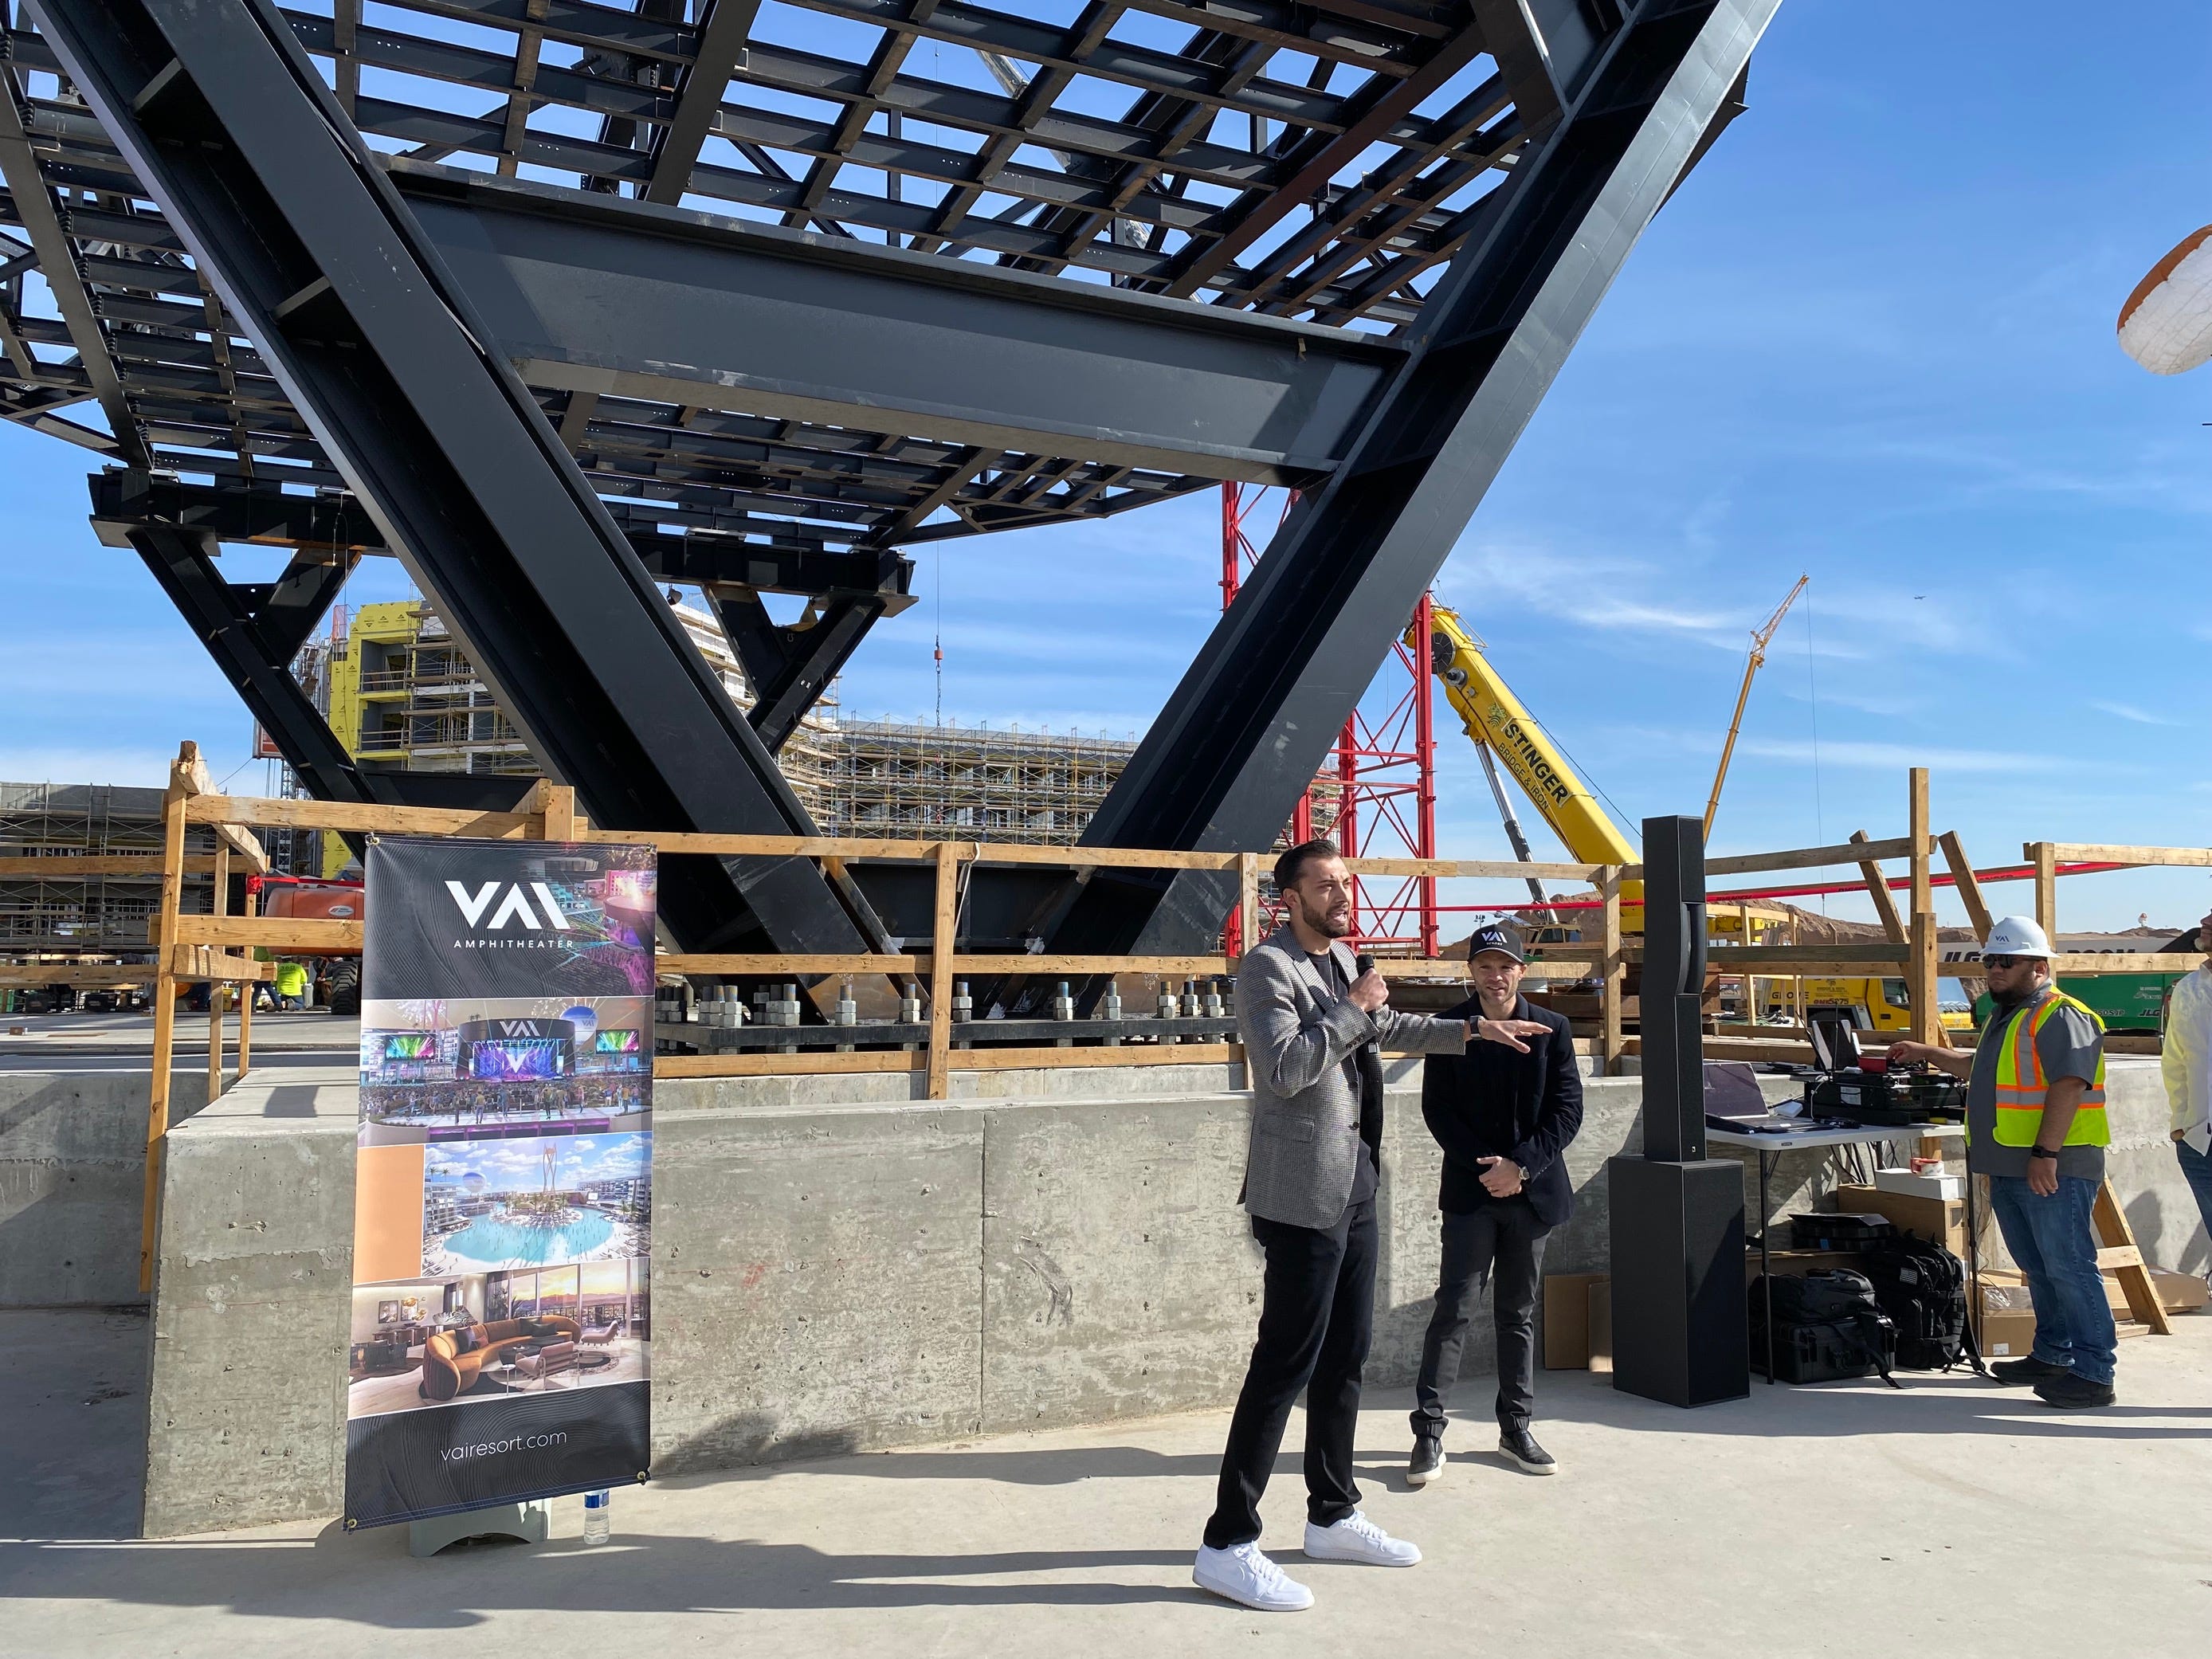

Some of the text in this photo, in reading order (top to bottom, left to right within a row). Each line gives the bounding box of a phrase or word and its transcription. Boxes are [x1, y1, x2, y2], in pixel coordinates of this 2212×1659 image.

[1498, 743, 1549, 810] BRIDGE & IRON
[1504, 724, 1568, 804] STINGER
[445, 880, 571, 929] VAI
[453, 939, 574, 950] AMPHITHEATER
[441, 1431, 567, 1461] vairesort.com
